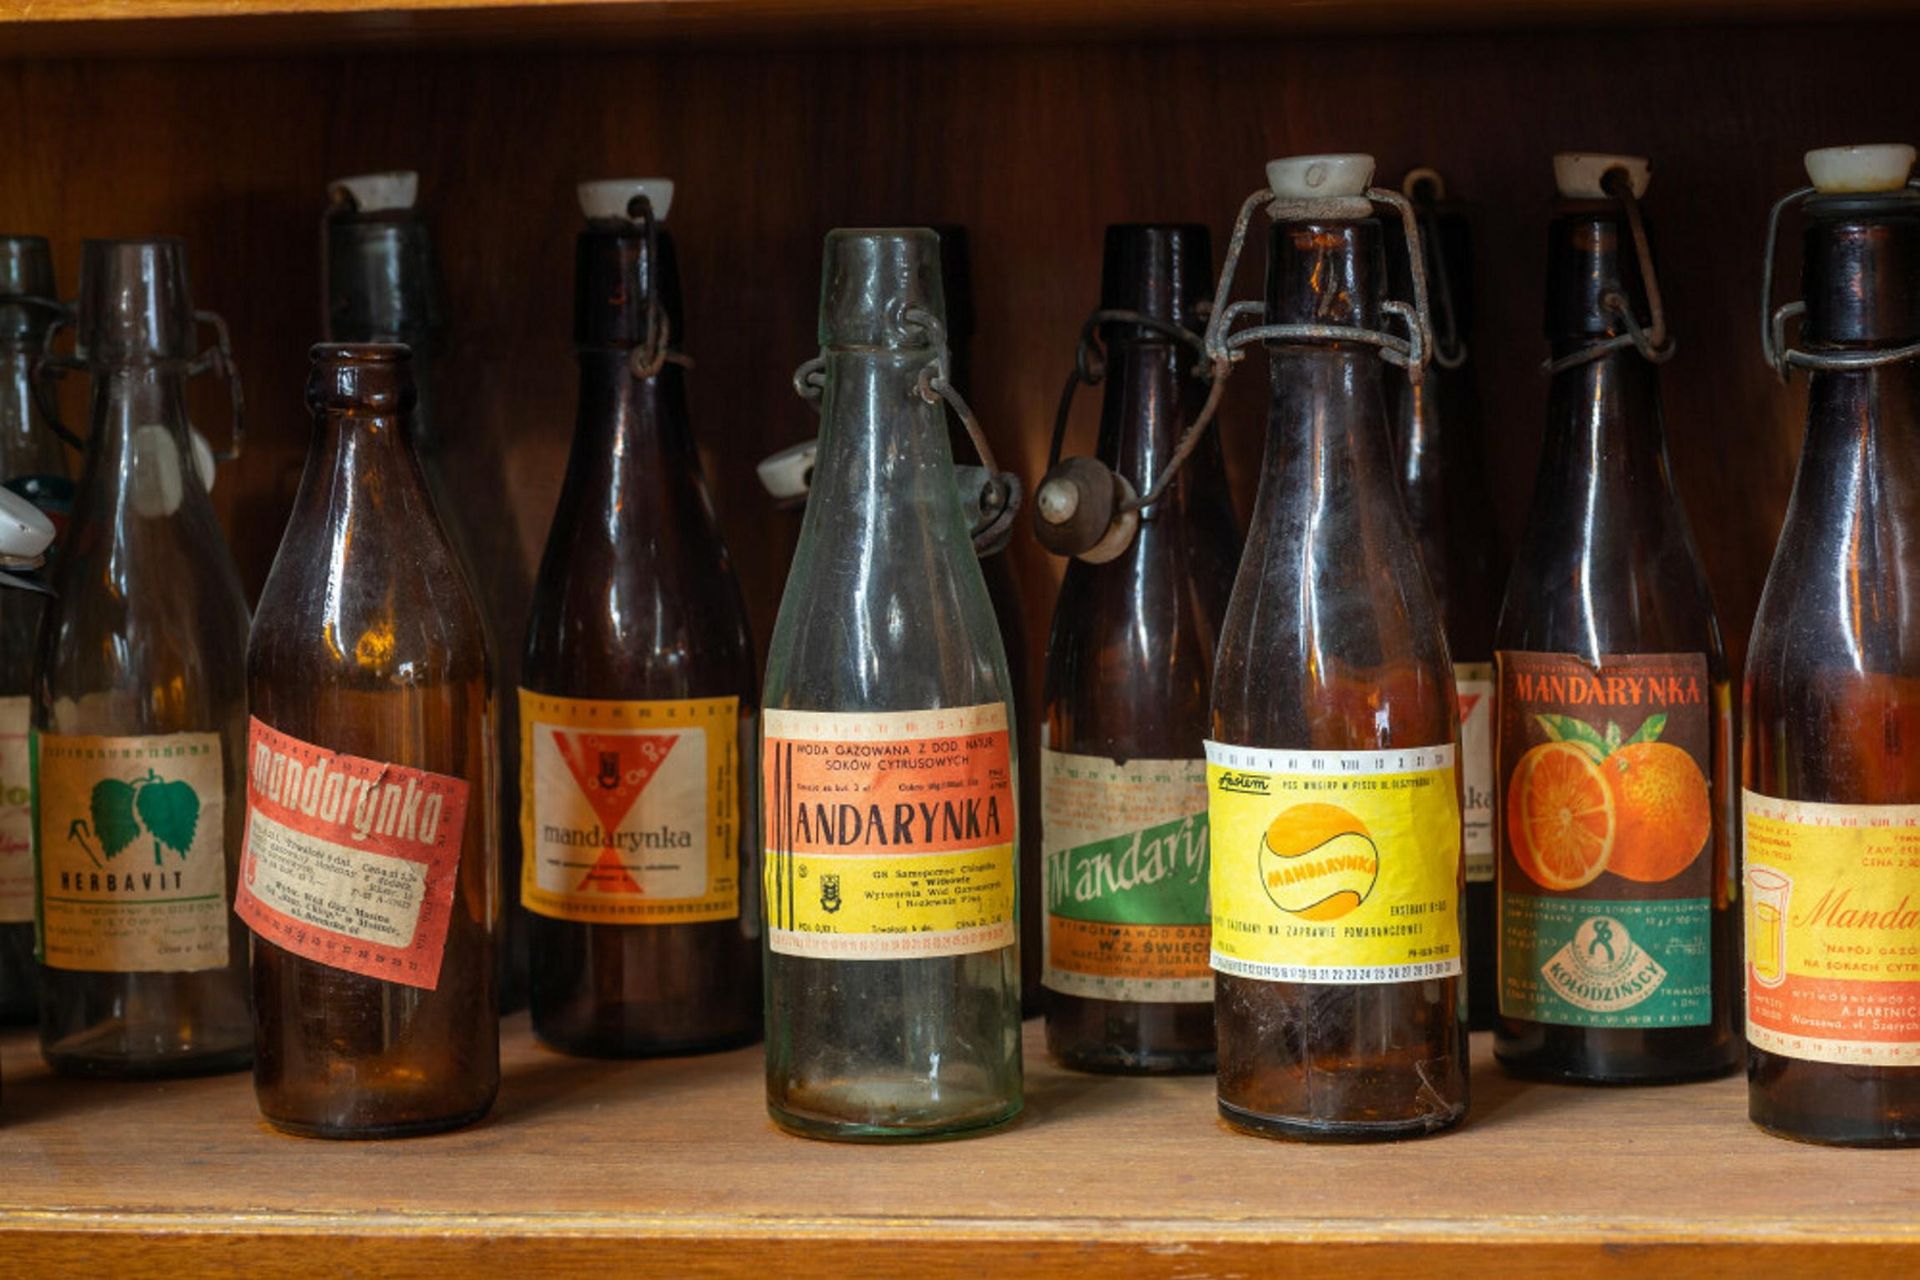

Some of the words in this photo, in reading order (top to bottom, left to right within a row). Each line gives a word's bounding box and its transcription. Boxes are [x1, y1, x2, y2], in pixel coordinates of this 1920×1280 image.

[1516, 674, 1700, 706] MANDARYNKA
[835, 743, 911, 757] GAZOWANA
[919, 743, 927, 755] Z
[825, 757, 871, 771] SOKÓW
[877, 754, 969, 771] CYTRUSOWYCH
[253, 741, 443, 845] mandarynka
[1840, 818, 1857, 827] VII
[544, 825, 692, 852] mandarynka
[1267, 855, 1378, 888] MANDARYNKA
[61, 871, 183, 892] HERBAVIT
[1286, 925, 1336, 938] ZAPRAWIE
[1827, 943, 1871, 955] NAPÓJ
[1826, 961, 1880, 972] SOKACH
[1332, 969, 1343, 980] 22
[1346, 969, 1357, 980] 23
[1359, 969, 1370, 980] 24
[1857, 1006, 1920, 1018] BARTNIC
